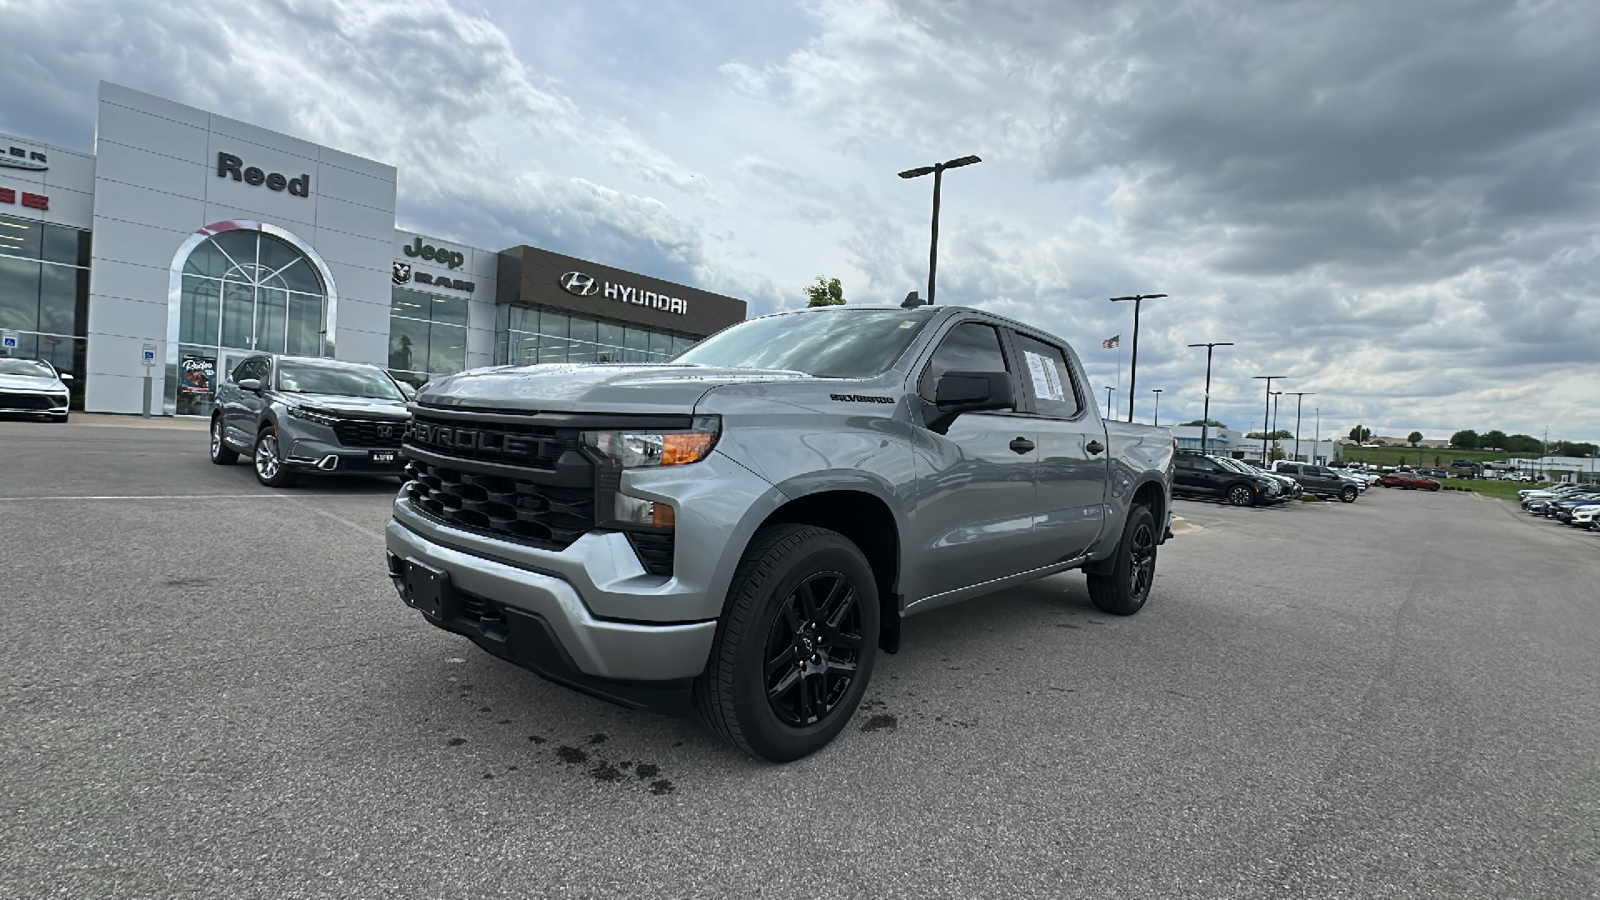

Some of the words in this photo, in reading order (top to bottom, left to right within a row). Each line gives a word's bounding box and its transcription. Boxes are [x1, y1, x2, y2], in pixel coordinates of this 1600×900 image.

[217, 152, 310, 198] Reed
[403, 237, 464, 270] Jeep
[414, 271, 475, 293] RAM
[604, 281, 688, 315] HYUNDAI
[404, 419, 556, 459] CHEVROLET
